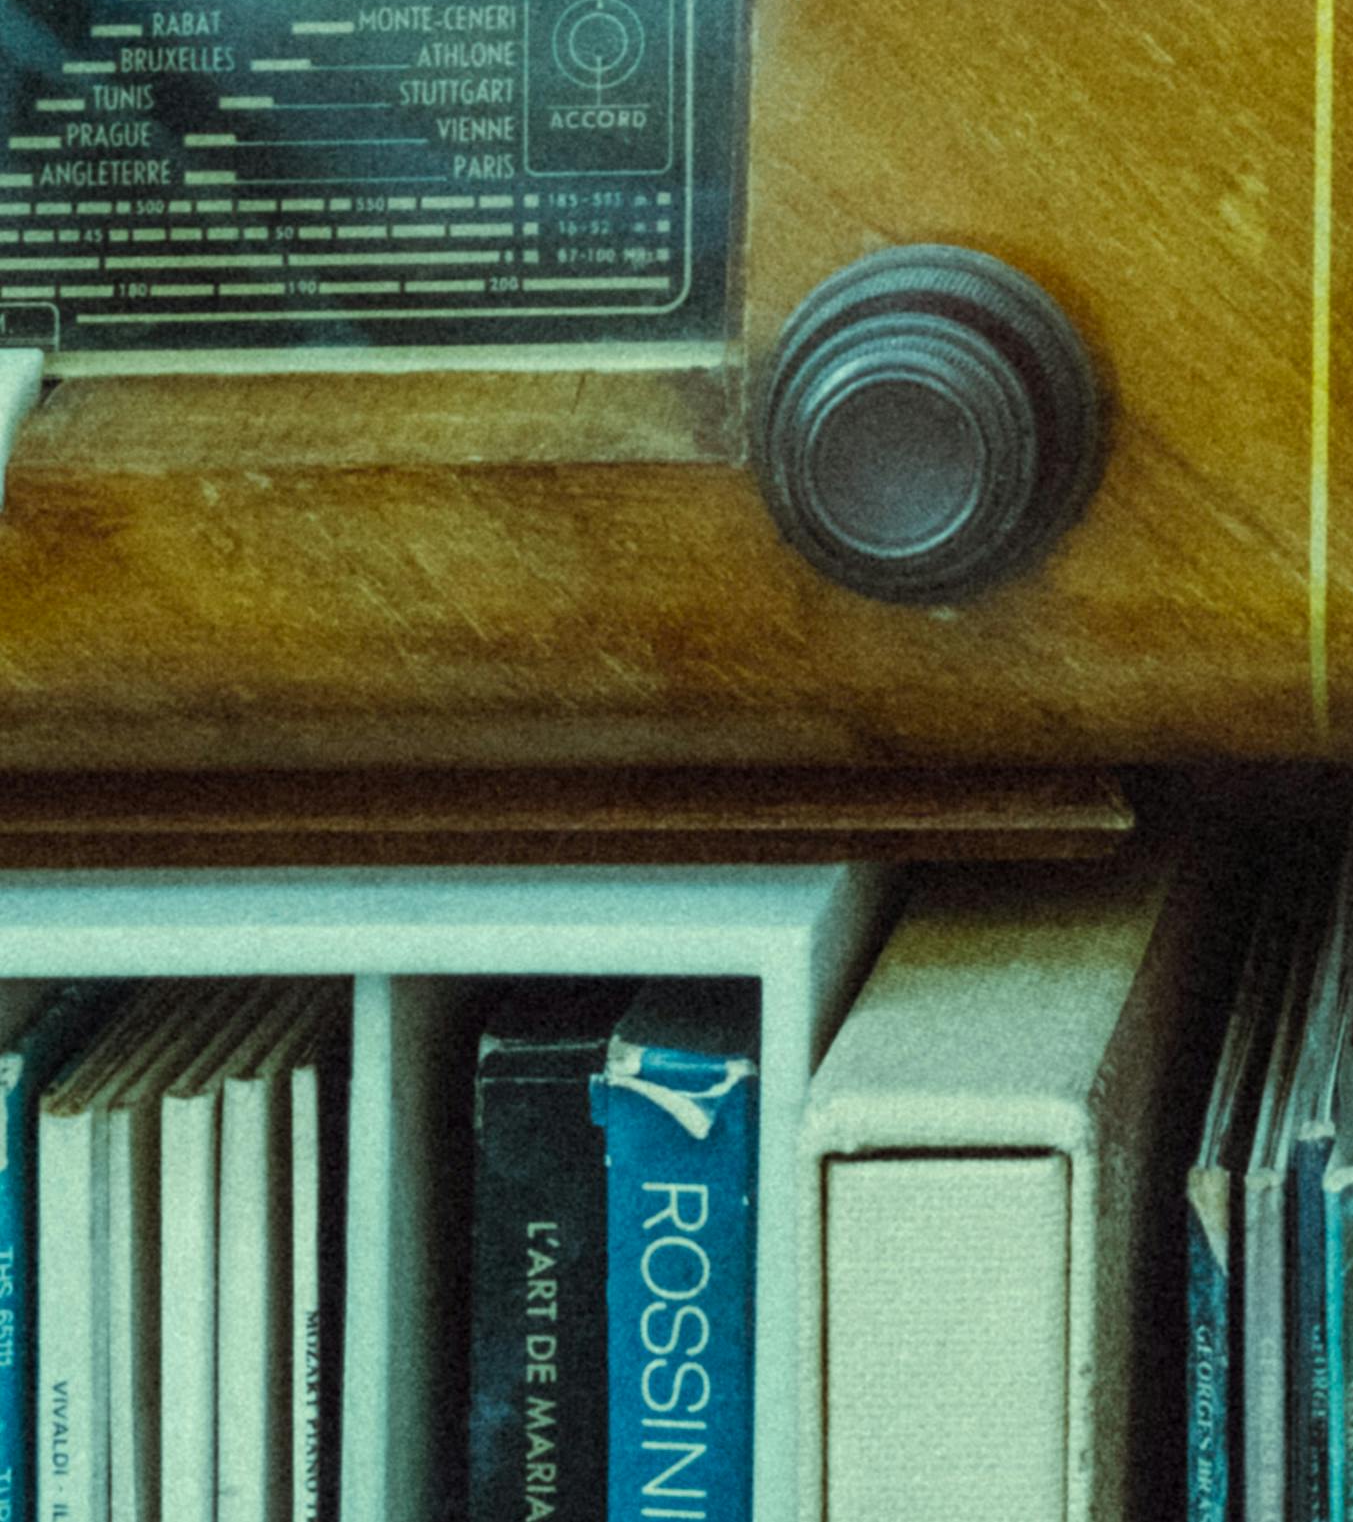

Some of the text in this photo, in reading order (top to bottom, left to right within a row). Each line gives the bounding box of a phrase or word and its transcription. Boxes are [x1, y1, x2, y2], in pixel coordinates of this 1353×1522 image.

[152, 10, 222, 38] RABAT
[357, 4, 517, 32] MONTE-CENERI
[120, 46, 236, 74] BRUXELLES
[416, 41, 517, 68] ATHLONE
[91, 84, 155, 111] TUNIS
[399, 78, 514, 107] STUTTGART
[436, 116, 516, 143] VIENNE
[549, 110, 648, 130] ACCORD
[66, 122, 152, 148] PRAGUE
[39, 159, 172, 186] ANGLETERRE
[453, 153, 516, 181] PARIS
[135, 199, 165, 216] 500
[355, 197, 385, 213] 550
[82, 228, 103, 243] 45
[275, 226, 294, 241] 50
[640, 1181, 711, 1520] ROSSINI
[525, 1220, 560, 1522] L'ART DE MARIA
[50, 1379, 71, 1476] VIVALDI
